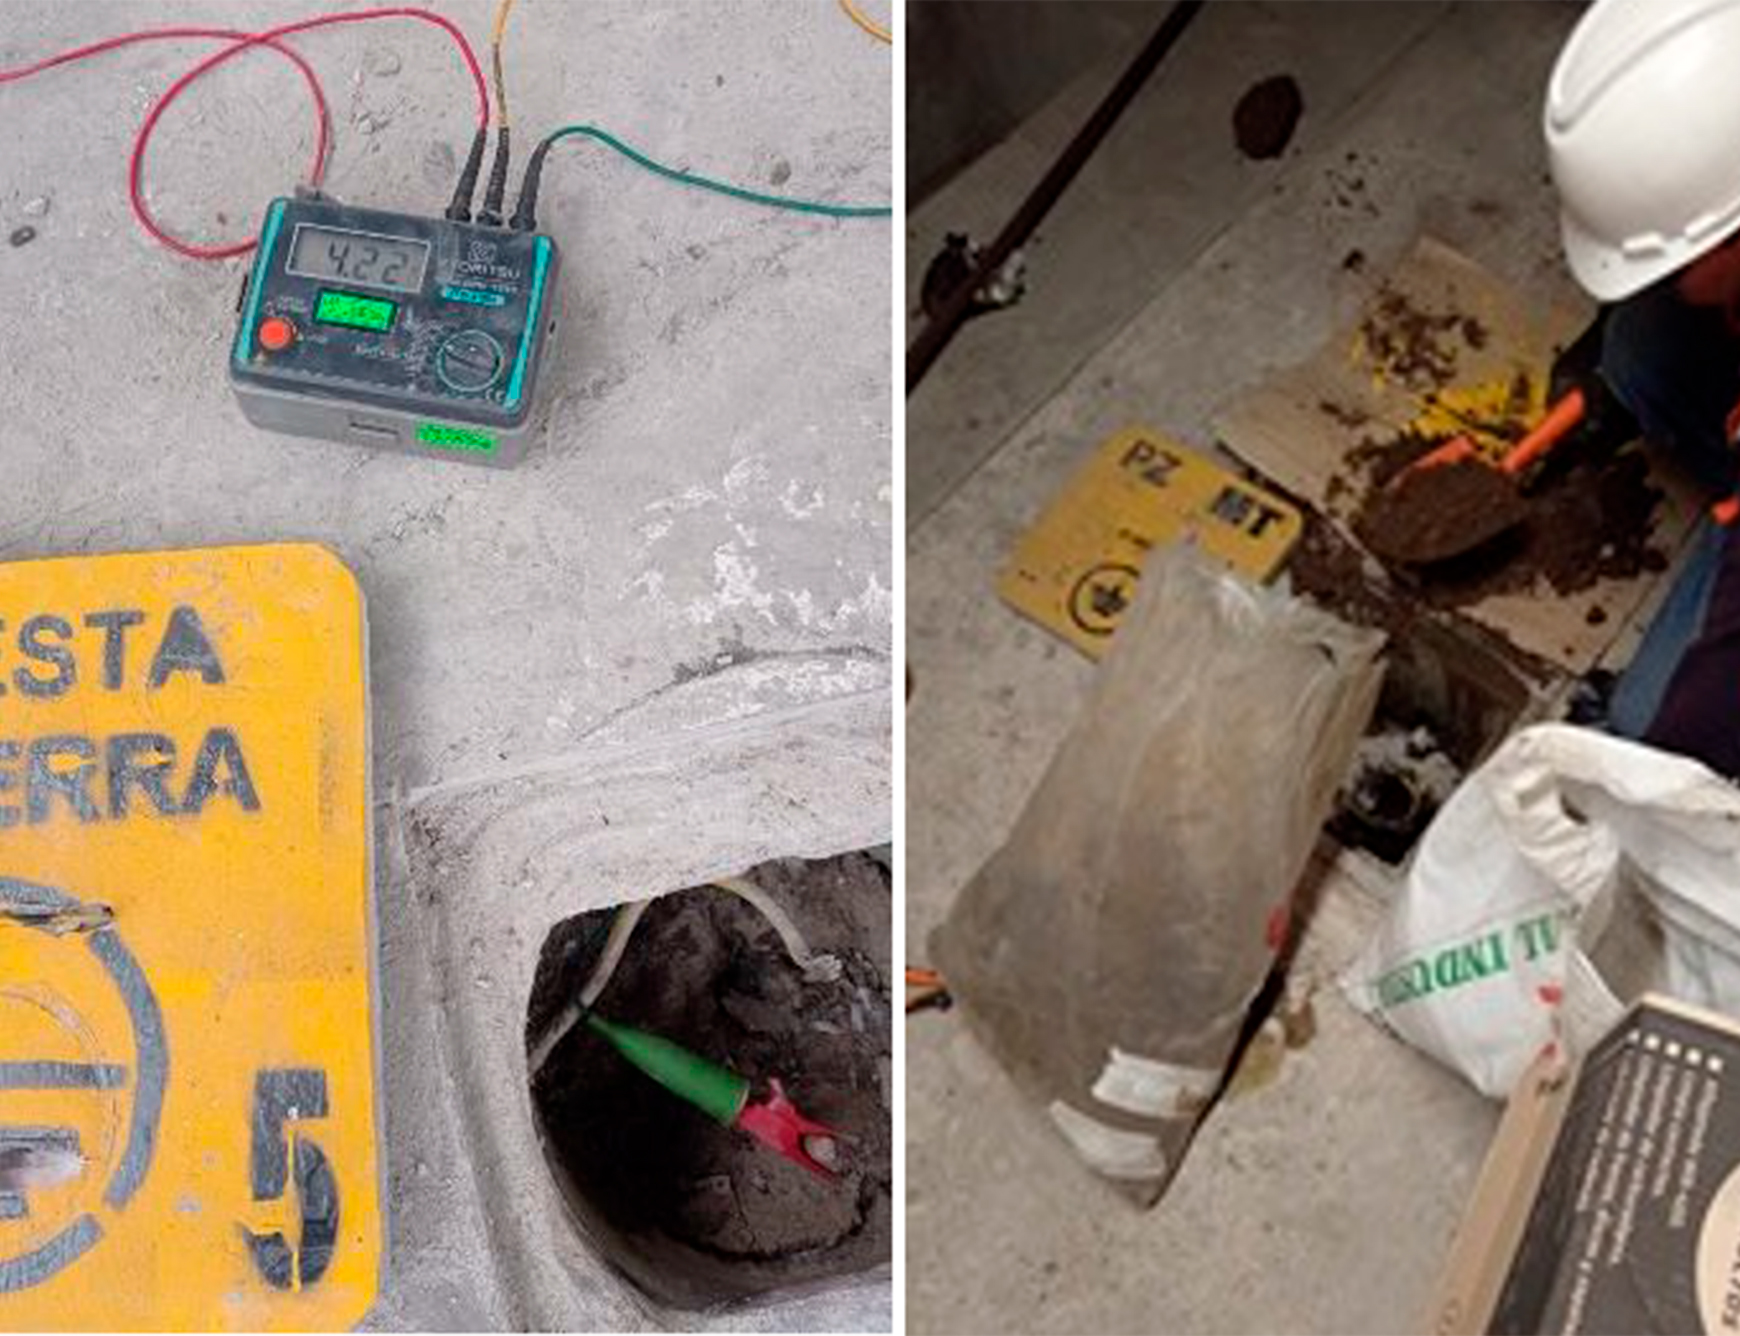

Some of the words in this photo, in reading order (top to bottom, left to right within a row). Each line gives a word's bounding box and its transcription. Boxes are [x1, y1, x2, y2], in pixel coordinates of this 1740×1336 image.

[328, 241, 409, 284] 4.22
[1119, 438, 1182, 488] PZ
[0, 604, 226, 698] STA
[242, 1067, 340, 1293] 5
